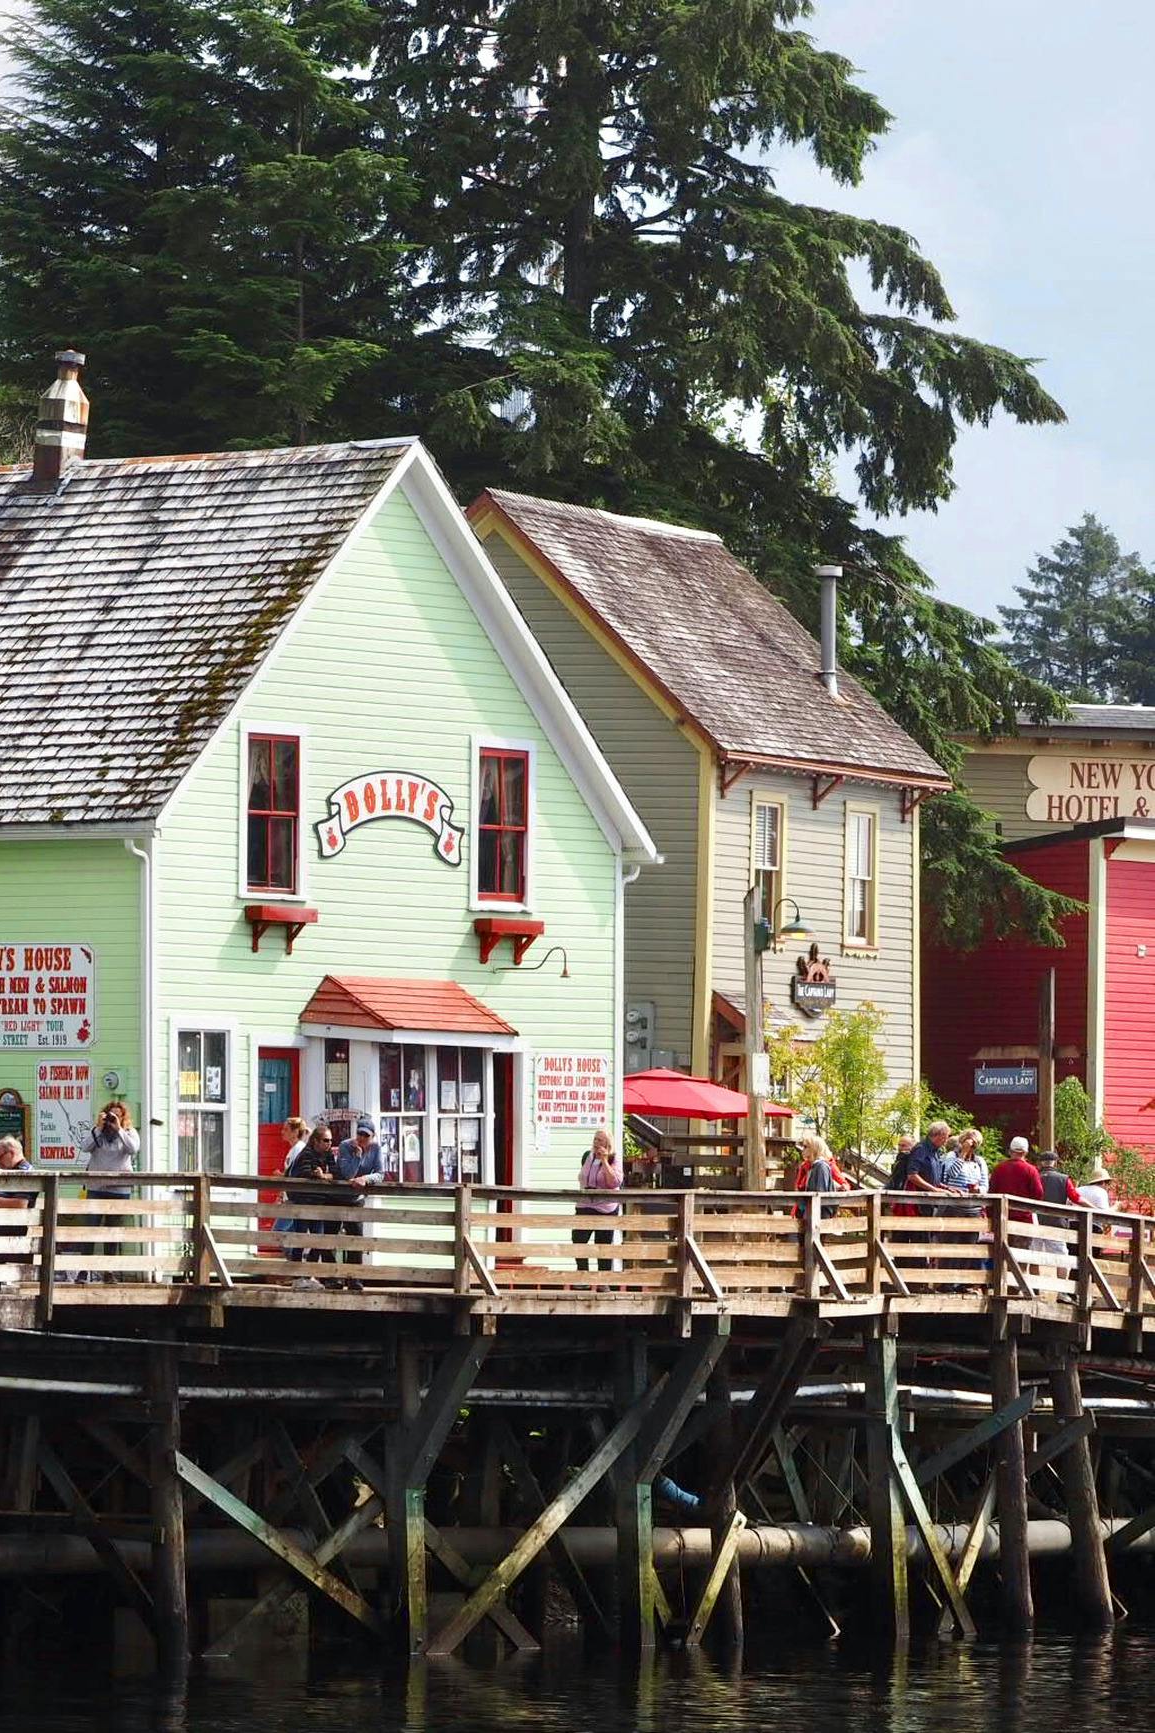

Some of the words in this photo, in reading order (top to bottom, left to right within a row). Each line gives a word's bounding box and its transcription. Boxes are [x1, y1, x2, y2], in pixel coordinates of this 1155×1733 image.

[1069, 762, 1123, 789] NEW
[344, 778, 439, 823] DOLLY'S
[1133, 796, 1150, 817] &
[24, 947, 72, 971] HOUSE
[9, 977, 30, 994] MEN
[35, 977, 45, 994] &
[48, 977, 87, 994] SALMON
[33, 998, 46, 1015] TO
[50, 998, 86, 1015] SPAWN
[46, 1020, 64, 1031] TOUR
[3, 1034, 29, 1046] STREET
[52, 1035, 67, 1046] 1919
[39, 1065, 47, 1081] GO
[50, 1065, 73, 1081] FISHING
[75, 1065, 89, 1081] NOW
[544, 1057, 573, 1072] DOLLY'S
[576, 1057, 602, 1073] HOUSE
[1015, 1075, 1034, 1086] LADY
[39, 1085, 61, 1100] SALMON
[64, 1085, 74, 1100] ARE
[76, 1085, 83, 1100] IN
[40, 1122, 56, 1131] Tackle
[39, 1146, 75, 1160] RENTALS
